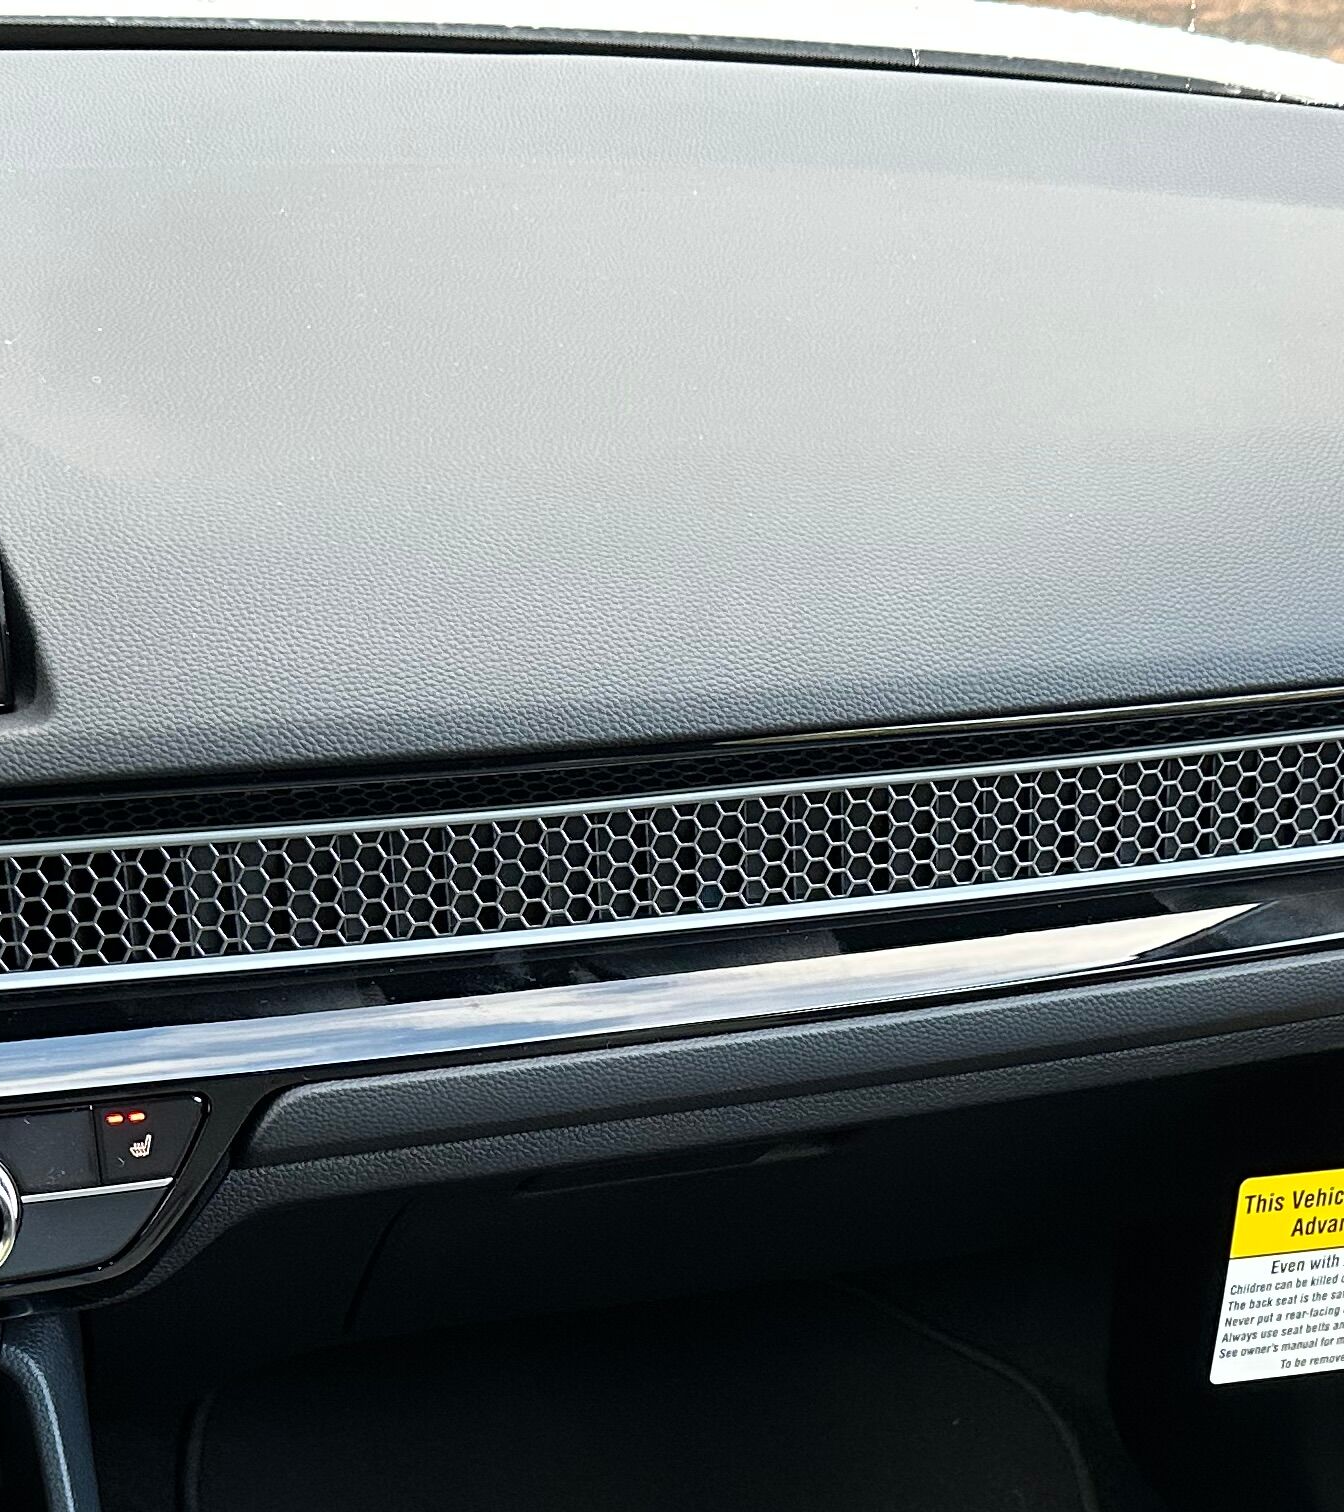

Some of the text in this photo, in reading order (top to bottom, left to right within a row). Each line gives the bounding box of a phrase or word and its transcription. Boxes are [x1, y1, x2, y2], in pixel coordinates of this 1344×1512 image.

[1244, 1193, 1285, 1214] This
[1271, 1260, 1305, 1275] Even
[1310, 1254, 1340, 1270] with
[1230, 1283, 1272, 1296] Children
[1274, 1280, 1293, 1291] can
[1296, 1278, 1308, 1289] be
[1310, 1273, 1338, 1287] killed
[1228, 1301, 1246, 1311] The
[1249, 1298, 1273, 1309] back
[1275, 1295, 1297, 1306] seat
[1300, 1294, 1309, 1304] is
[1312, 1291, 1328, 1302] the
[1224, 1315, 1255, 1327] Never
[1256, 1313, 1274, 1326] put
[1276, 1312, 1282, 1321] a
[1285, 1305, 1341, 1320] rear-facing
[1221, 1330, 1257, 1343] Always
[1260, 1329, 1278, 1339] use
[1281, 1325, 1303, 1336] seat
[1306, 1322, 1330, 1333] belts
[1219, 1348, 1238, 1359] See
[1240, 1343, 1279, 1356] owner's
[1281, 1337, 1318, 1351] manual
[1320, 1336, 1334, 1347] for
[1281, 1359, 1291, 1369] To
[1294, 1357, 1306, 1367] be
